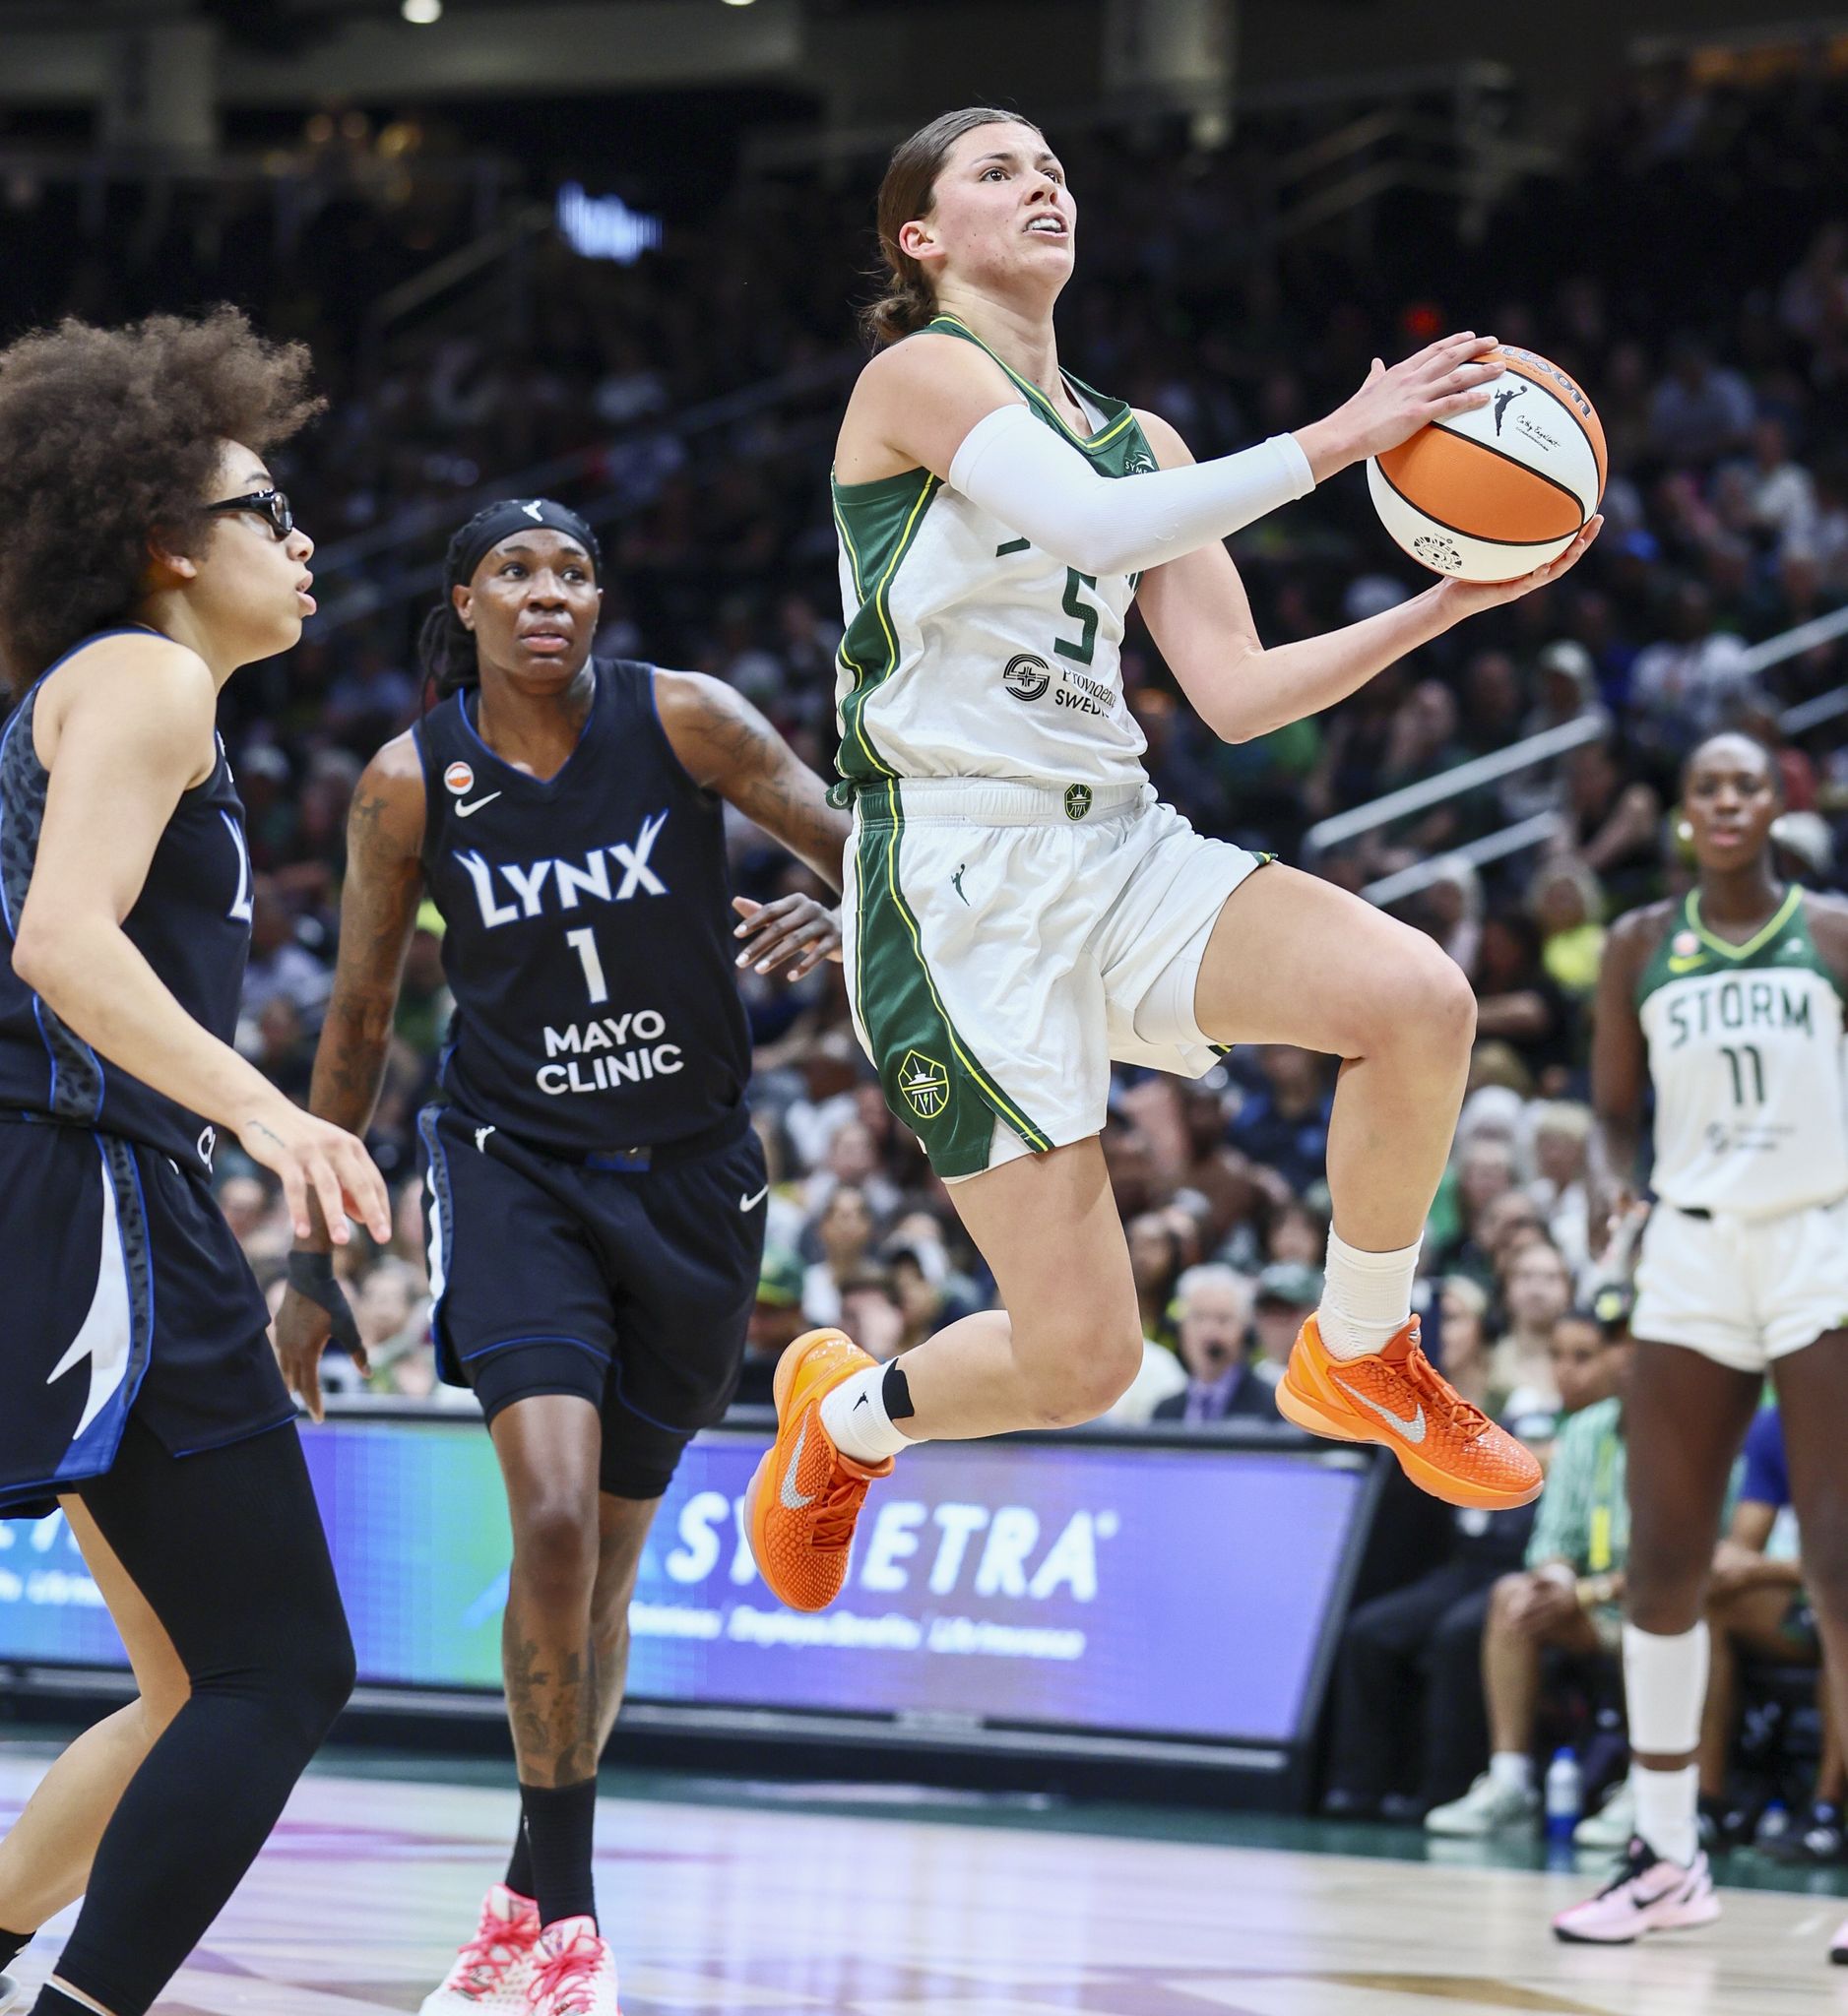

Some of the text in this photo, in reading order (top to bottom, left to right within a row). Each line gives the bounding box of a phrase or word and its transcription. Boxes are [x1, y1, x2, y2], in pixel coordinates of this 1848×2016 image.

[1053, 565, 1099, 666] 5
[1054, 688, 1110, 719] SWED
[1062, 668, 1116, 708] Providen
[453, 807, 669, 929] LYNX
[565, 926, 608, 1004] 1
[542, 1009, 667, 1058] MAYO
[1668, 980, 1815, 1051] STORM
[536, 1043, 685, 1096] CLINIC
[1718, 1042, 1765, 1106] 11
[665, 1490, 1100, 1603] SETRA
